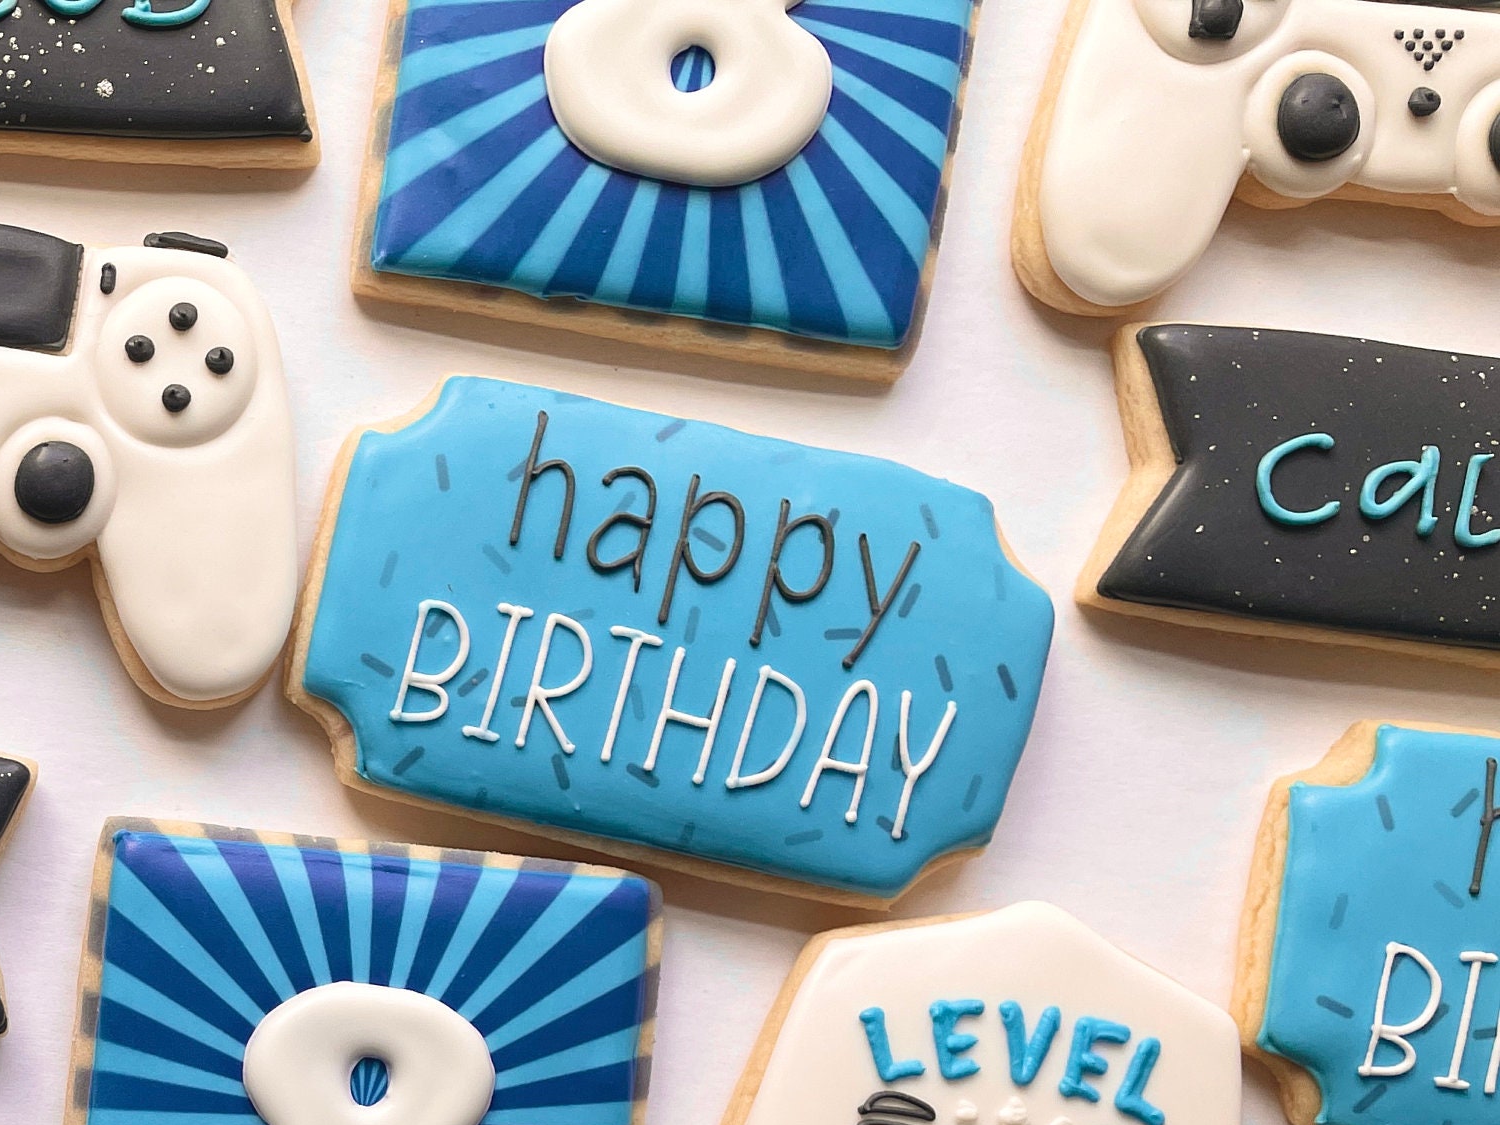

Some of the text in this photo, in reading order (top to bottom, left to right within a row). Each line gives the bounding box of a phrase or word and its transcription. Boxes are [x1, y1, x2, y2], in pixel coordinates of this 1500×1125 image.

[510, 410, 921, 668] happy
[389, 600, 958, 839] BIRTHDAY
[1358, 941, 1500, 1093] BI
